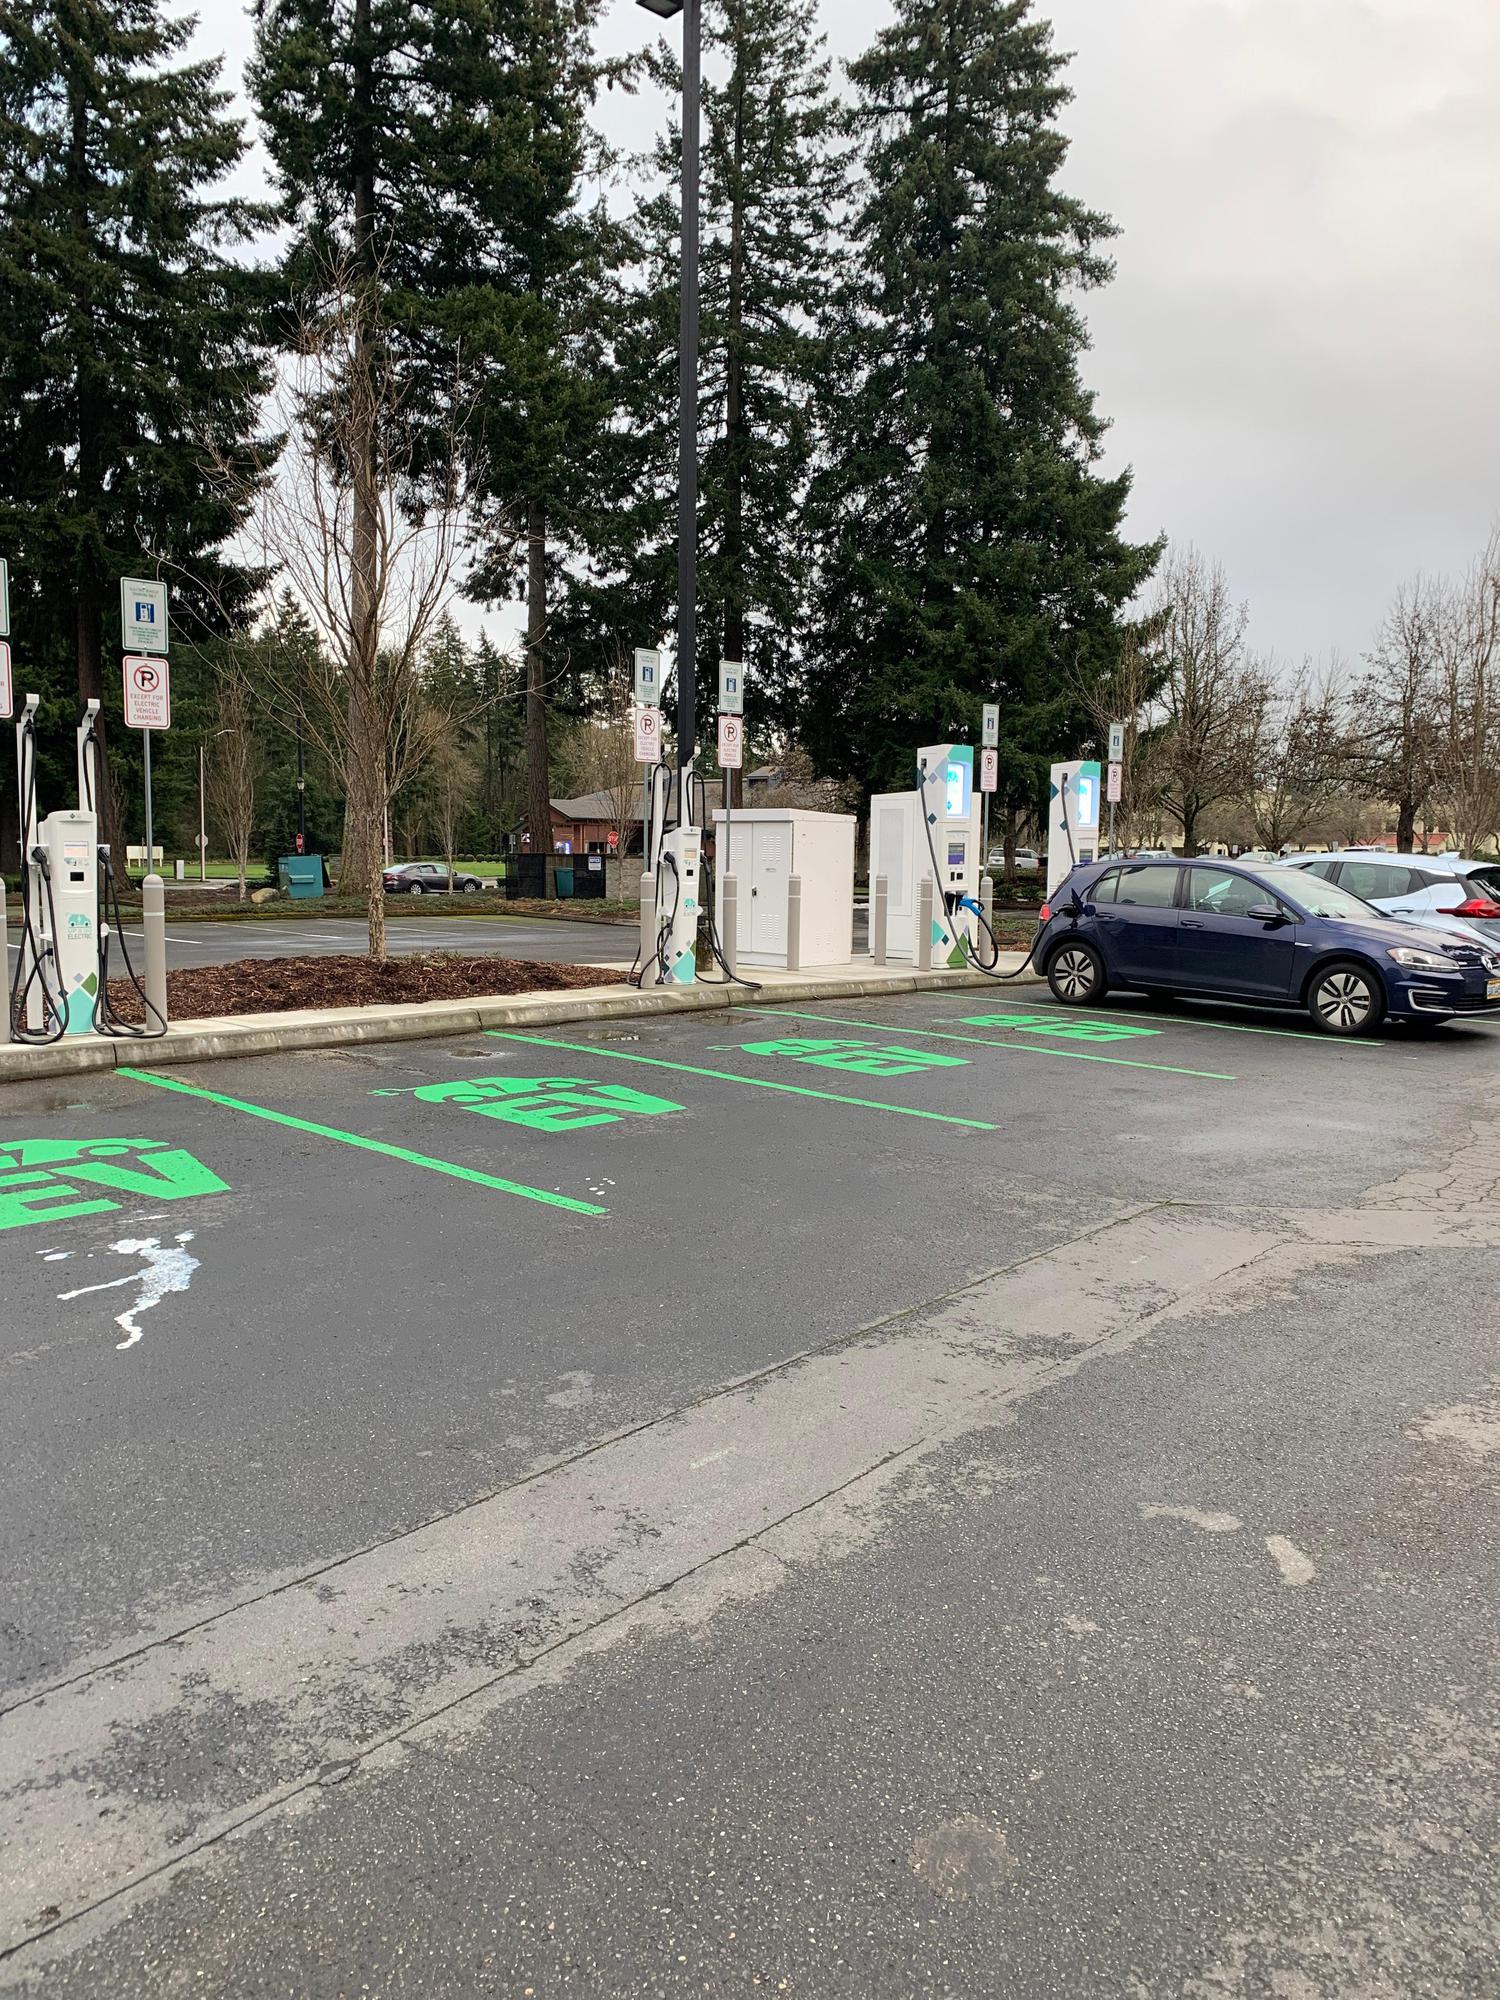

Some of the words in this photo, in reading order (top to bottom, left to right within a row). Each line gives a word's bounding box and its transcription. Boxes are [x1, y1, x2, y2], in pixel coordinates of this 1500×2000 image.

[134, 700, 160, 708] ELECTRIC
[1014, 1020, 1165, 1042] EV
[793, 1046, 973, 1077] EV
[461, 1084, 688, 1132] EV
